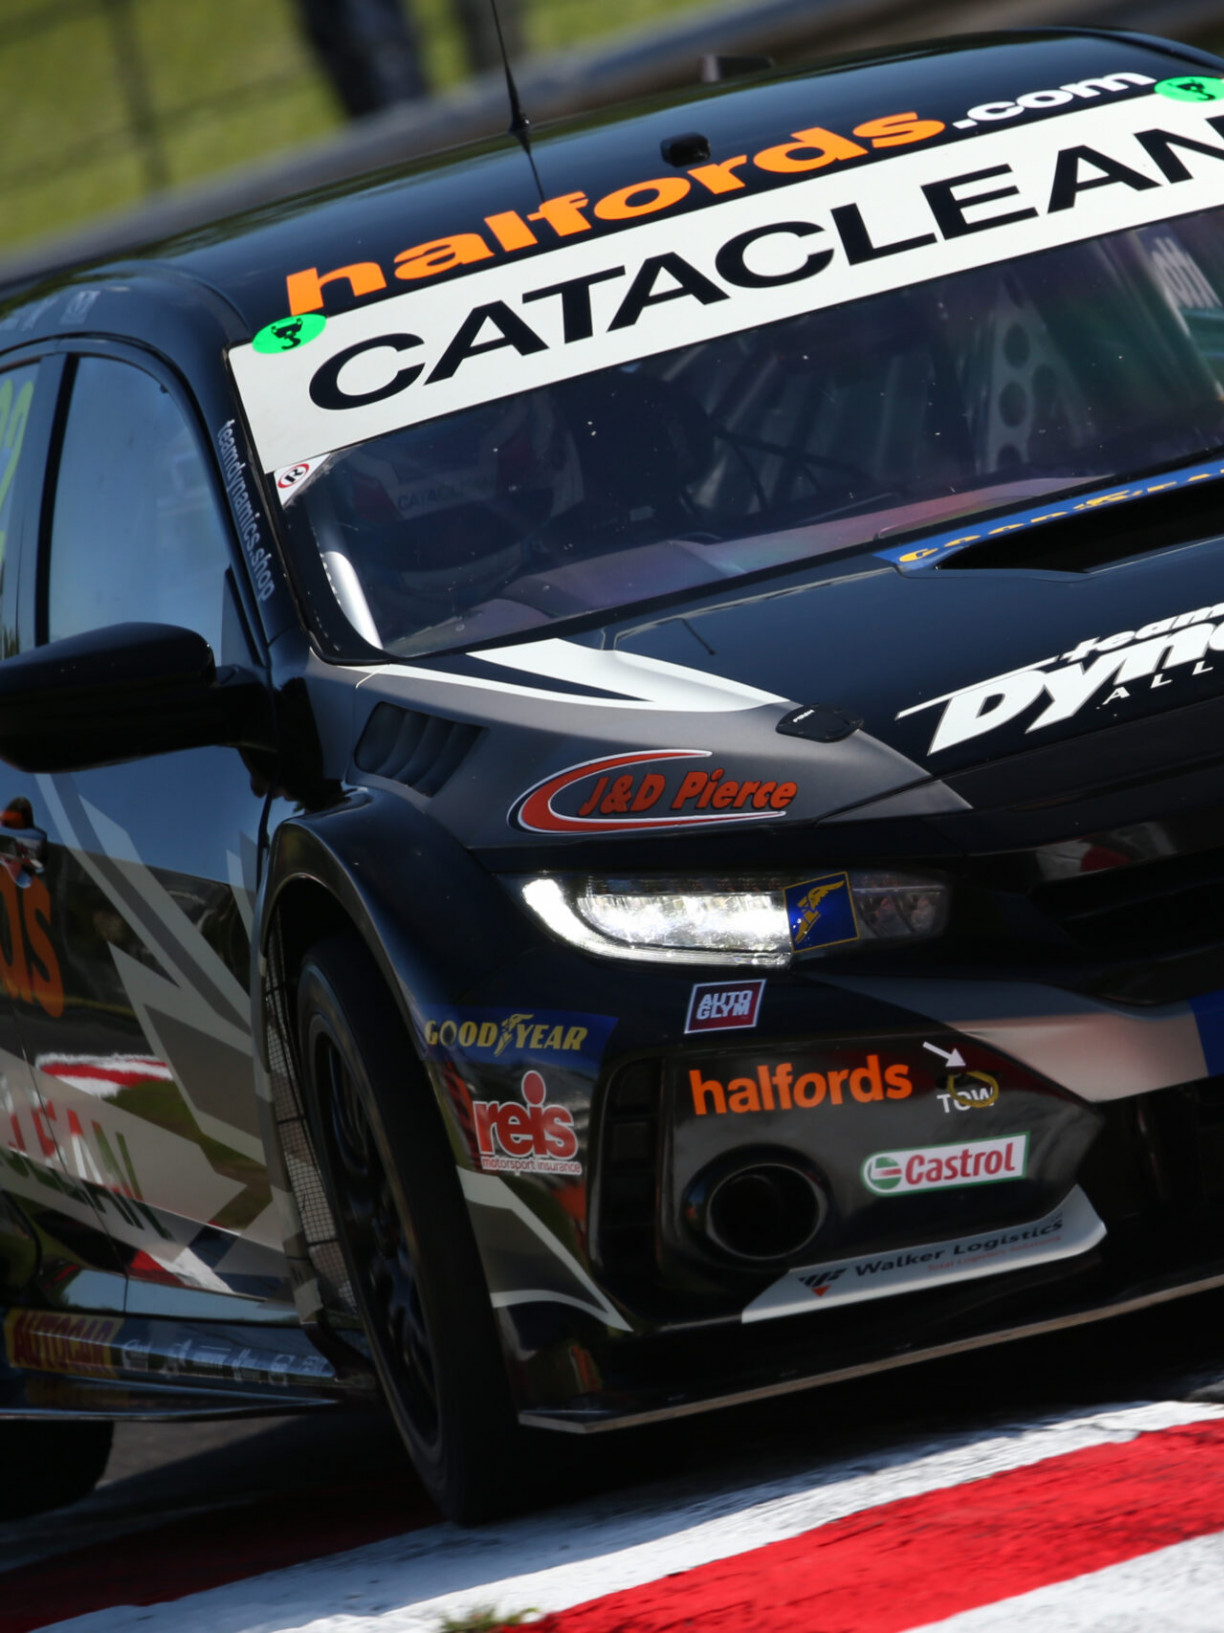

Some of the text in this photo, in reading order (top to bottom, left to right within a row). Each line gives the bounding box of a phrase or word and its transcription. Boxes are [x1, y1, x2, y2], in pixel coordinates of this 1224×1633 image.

[286, 72, 1157, 317] halfords.com
[217, 418, 276, 602] teamdynamics.shop
[577, 768, 798, 817] J&D Pierce
[695, 1003, 751, 1020] GLYM
[700, 989, 754, 1007] AUTO
[689, 1055, 914, 1116] halfords
[472, 1069, 579, 1160] reis
[482, 1158, 583, 1175] motorsport insurance
[905, 1142, 1015, 1186] Castrol
[854, 1218, 1063, 1278] Walker Logistics
